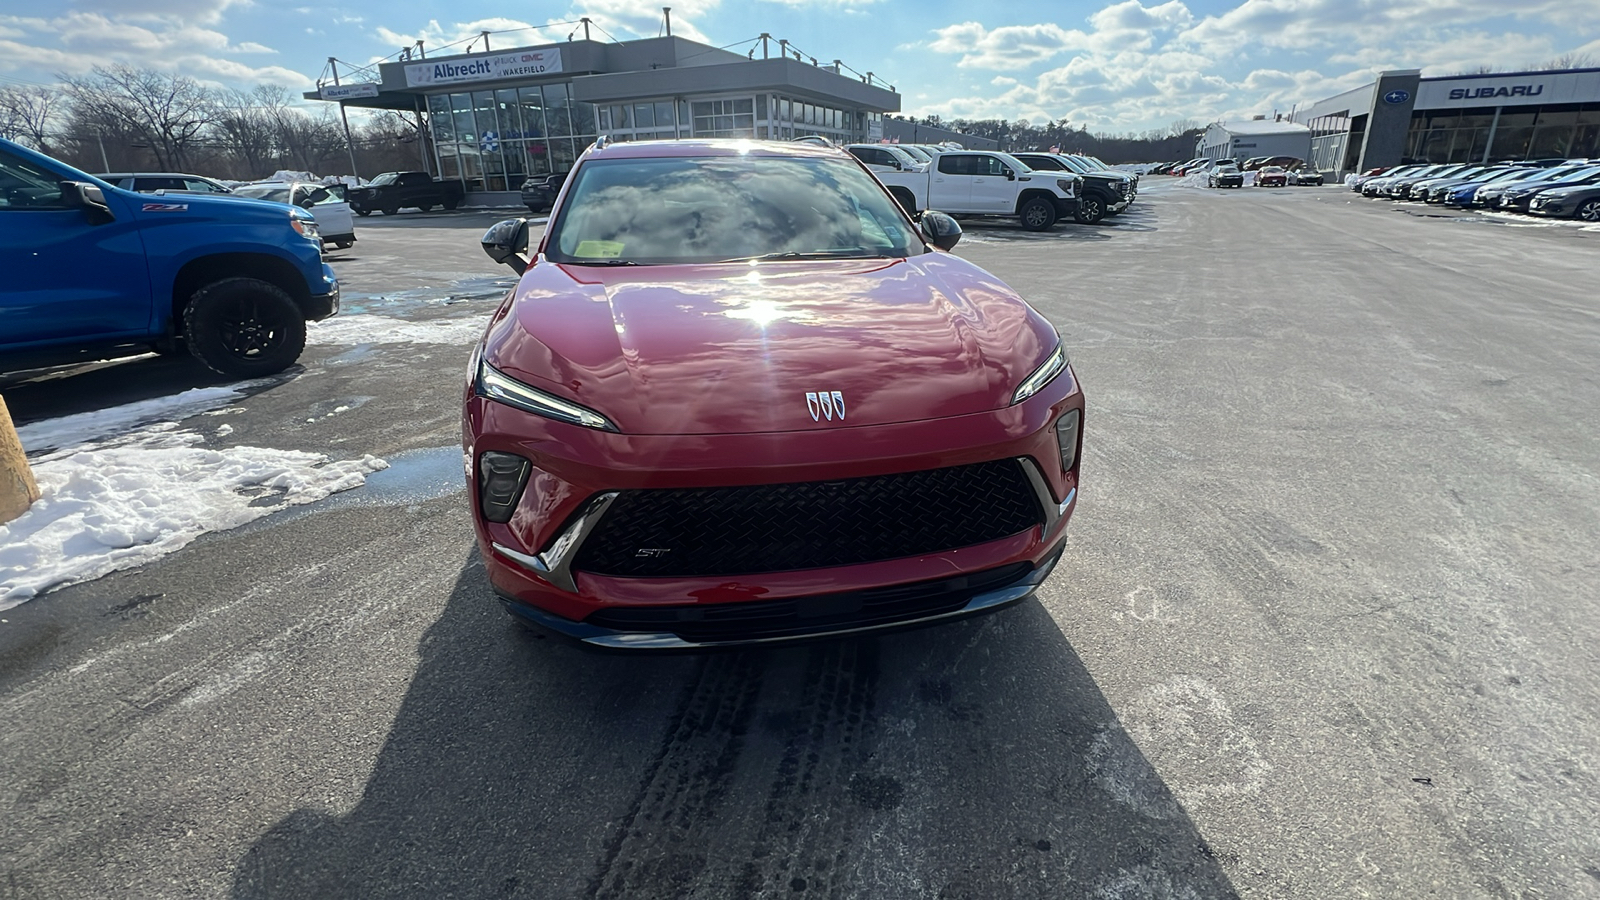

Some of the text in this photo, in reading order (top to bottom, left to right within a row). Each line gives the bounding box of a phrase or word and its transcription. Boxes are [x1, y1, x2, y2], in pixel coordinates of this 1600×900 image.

[521, 53, 544, 63] GMC
[434, 59, 491, 79] Albrecht
[502, 65, 546, 77] WAKEFIELD
[1449, 84, 1544, 100] SUBARU
[635, 548, 671, 558] ST
